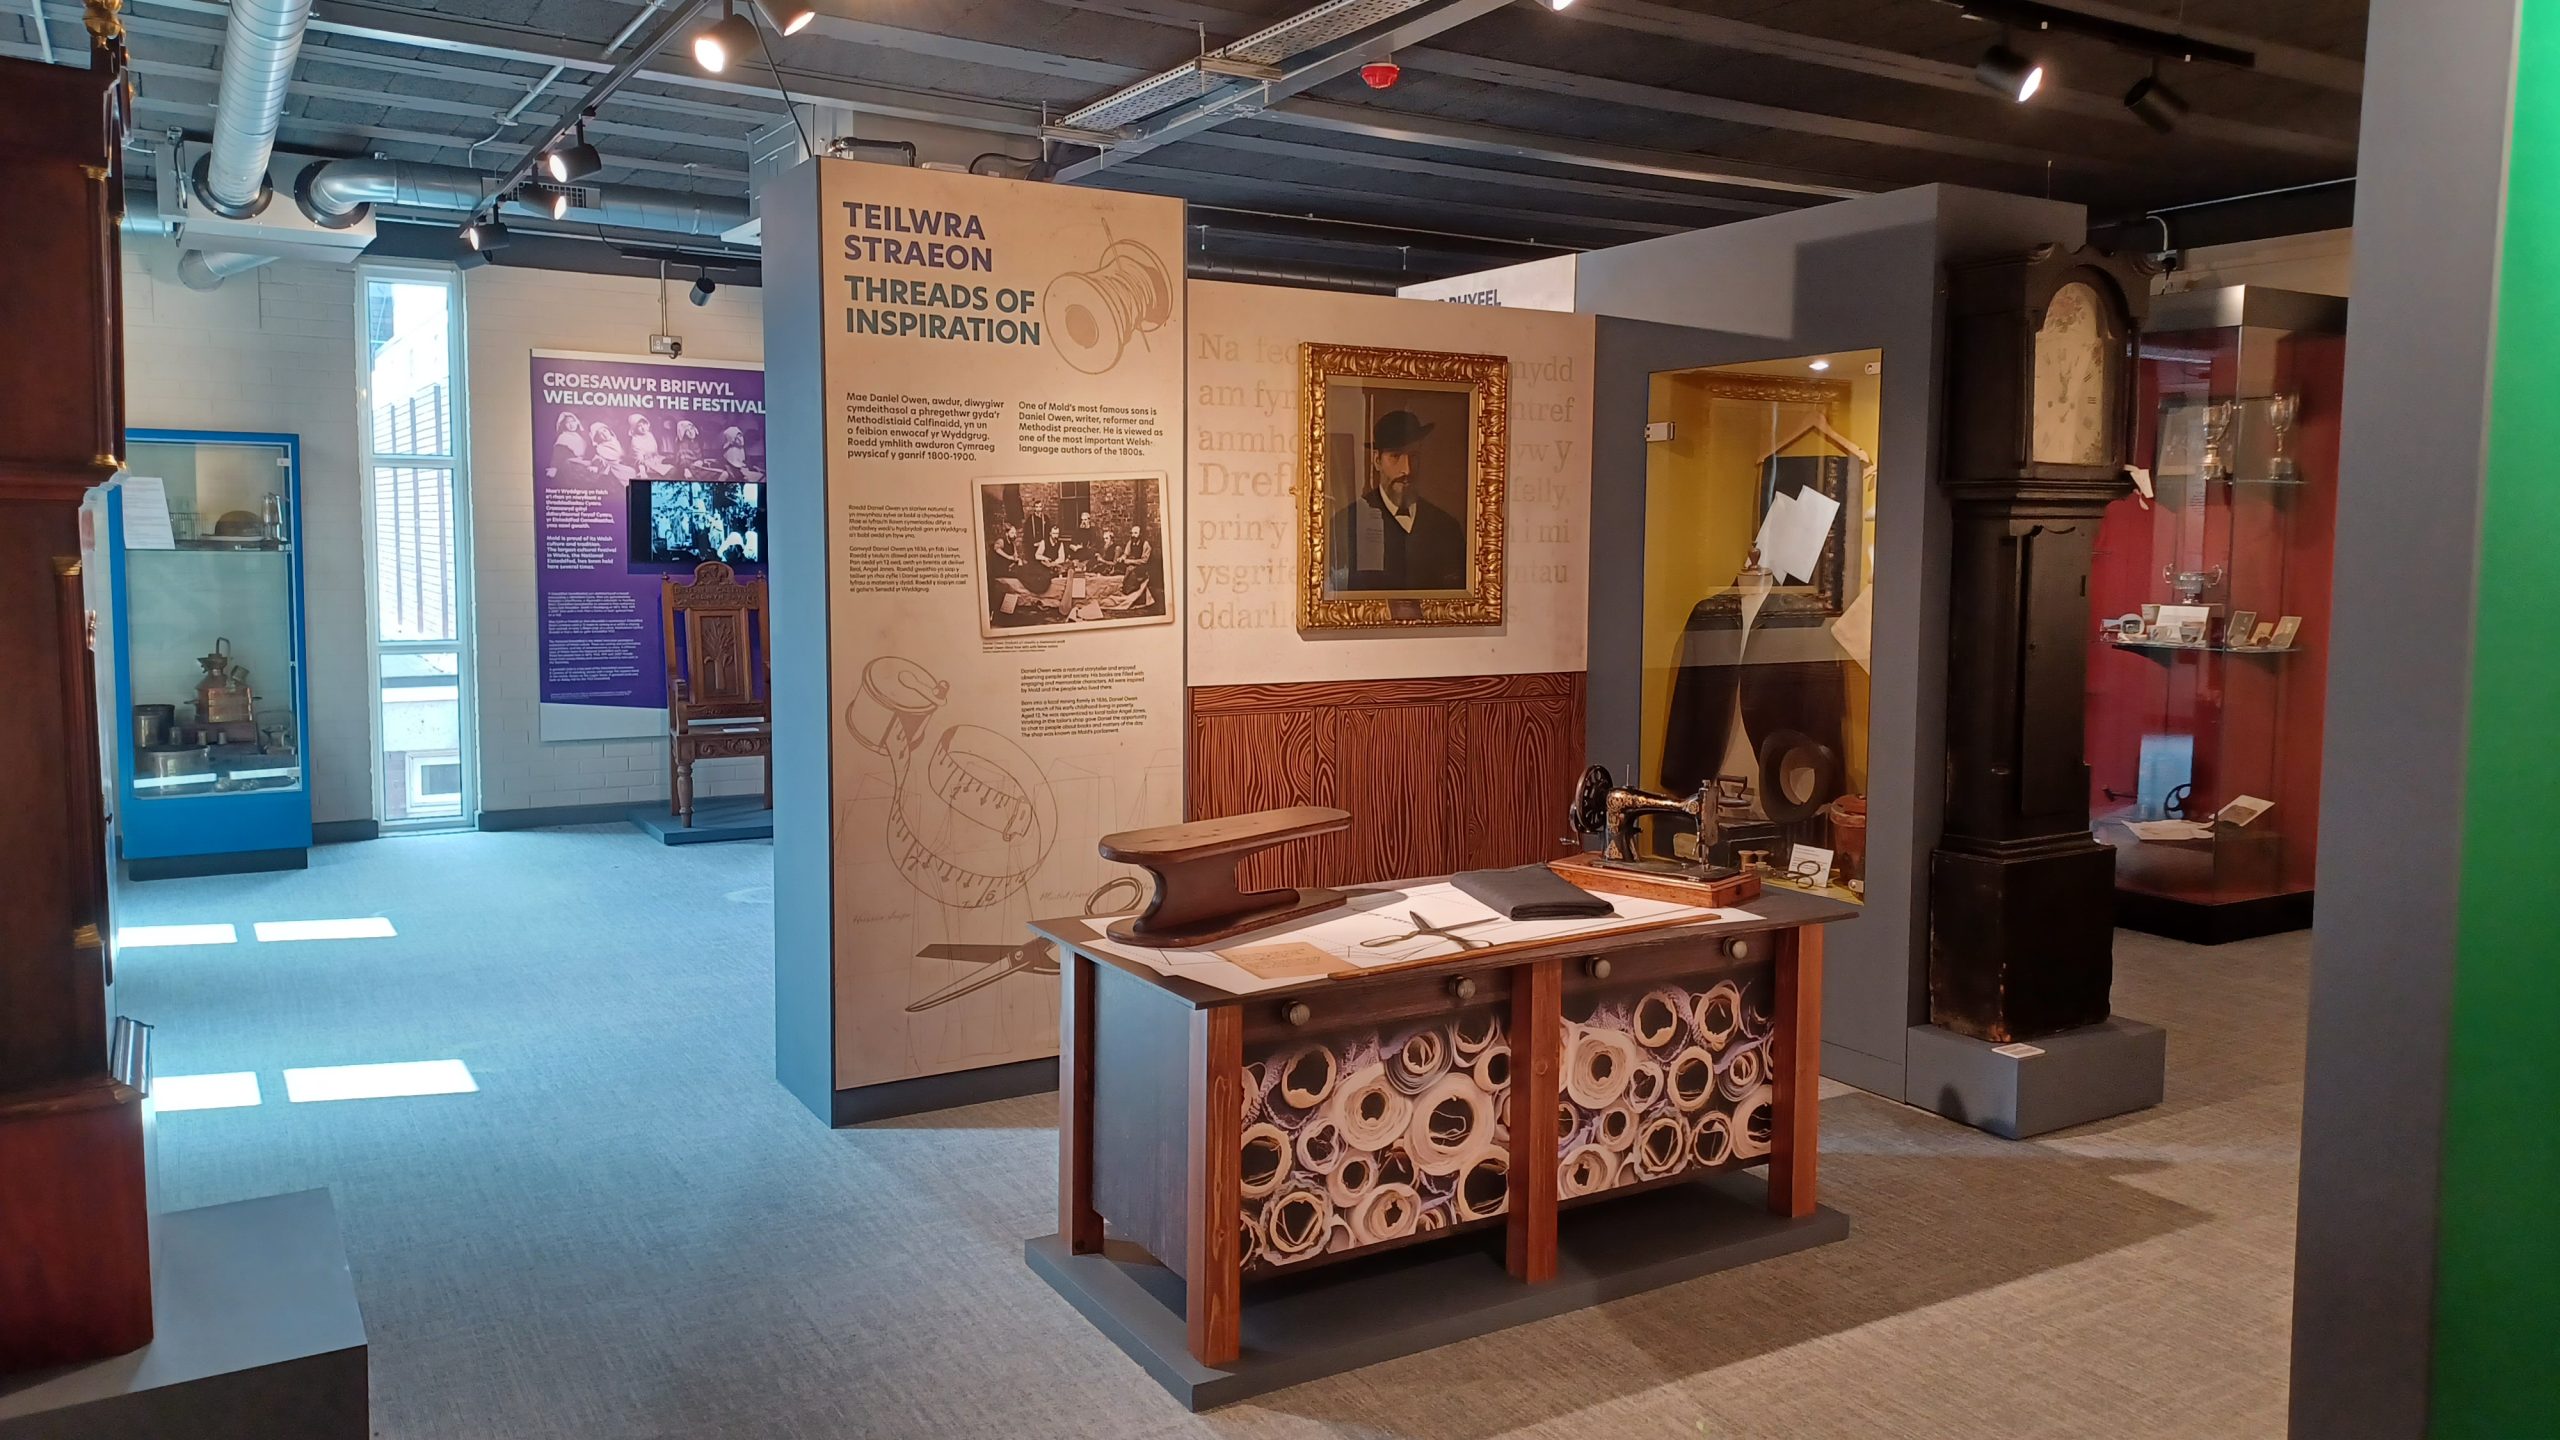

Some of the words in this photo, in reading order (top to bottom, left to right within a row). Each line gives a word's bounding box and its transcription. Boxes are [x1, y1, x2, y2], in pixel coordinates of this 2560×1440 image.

[842, 202, 985, 240] TEILWRA
[844, 235, 992, 272] STRAEON
[844, 275, 988, 311] THREADS
[996, 288, 1035, 314] OF
[846, 308, 1040, 345] INSPIRATION
[1198, 333, 1240, 362] Na
[543, 372, 656, 392] CROESAWU'R
[661, 379, 734, 396] BRIFWYL
[543, 389, 653, 409] WELCOMING
[656, 395, 689, 410] THE
[693, 398, 766, 414] FESTIVAL
[847, 393, 867, 401] Mae
[869, 394, 898, 403] Daniel
[900, 395, 929, 405] Owen,
[931, 397, 962, 407] awdur,
[964, 398, 1004, 409] diwygiwr
[1199, 383, 1245, 407] am
[847, 405, 908, 415] cymdeithasol
[918, 407, 970, 418] phregethwr
[972, 410, 1000, 419] gyda'r
[1018, 401, 1036, 410] One
[1037, 402, 1046, 410] of
[1048, 403, 1075, 411] Mold's
[1099, 405, 1129, 414] famous
[1150, 407, 1157, 415] is
[847, 415, 911, 425] Methodistiaid
[913, 418, 961, 429] Calfinaidd,
[963, 422, 974, 430] yn
[1019, 412, 1045, 421] Daniel
[1047, 413, 1073, 423] Owen,
[1075, 415, 1101, 424] writer,
[1102, 416, 1136, 424] reformer
[1138, 417, 1154, 425] and
[855, 427, 887, 435] feibion
[889, 429, 928, 437] enwocaf
[930, 431, 939, 439] yr
[941, 430, 989, 441] Wyddgrug.
[1019, 423, 1061, 432] Methodist
[1063, 425, 1101, 435] preacher.
[1102, 426, 1114, 434] He
[1115, 426, 1122, 434] is
[1124, 427, 1152, 435] viewed
[848, 438, 877, 446] Roedd
[879, 439, 912, 449] ymhlith
[914, 440, 954, 449] awduron
[956, 441, 995, 452] Cymraeg
[1036, 434, 1045, 442] of
[1047, 434, 1060, 442] the
[1062, 435, 1082, 443] most
[1084, 436, 1124, 446] important
[1126, 437, 1153, 445] Welsh-
[848, 450, 888, 460] pwysicaf
[890, 453, 895, 461] y
[897, 451, 925, 461] ganrif
[927, 452, 976, 461] 1800-1900.
[1019, 444, 1058, 455] language
[1060, 446, 1091, 454] authors
[1093, 446, 1102, 454] of
[1103, 447, 1117, 455] the
[1119, 447, 1145, 455] 1800s.
